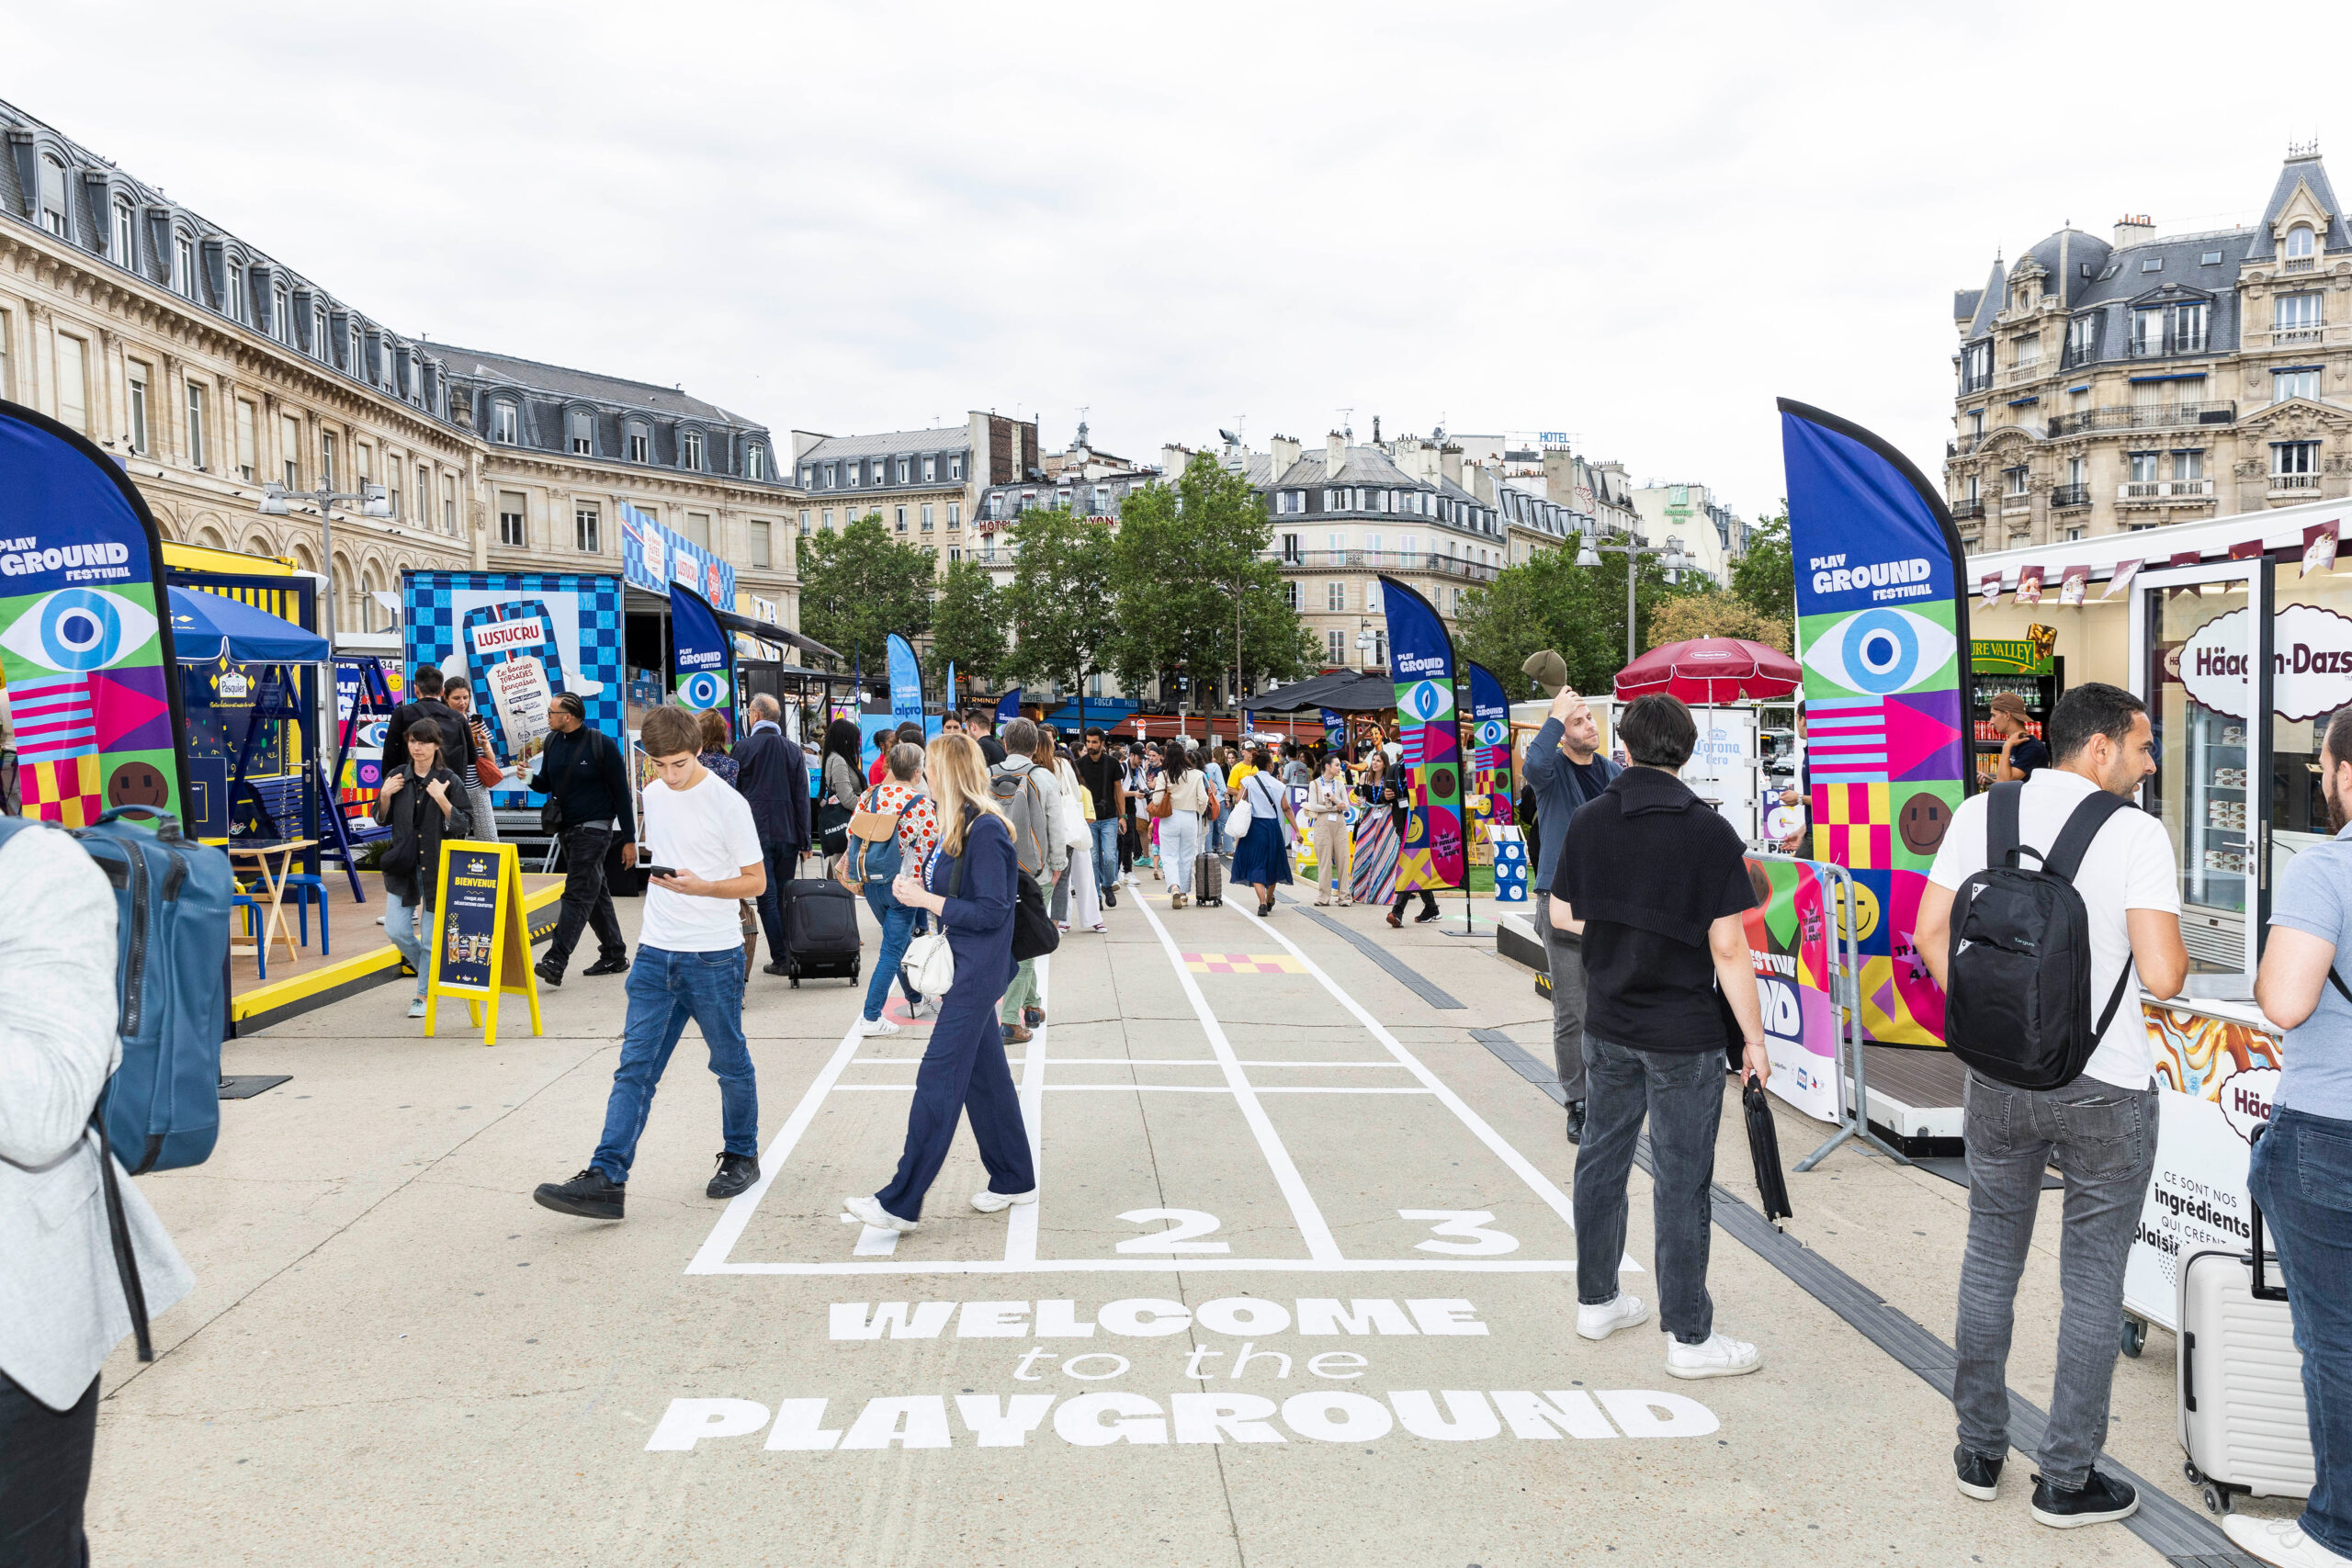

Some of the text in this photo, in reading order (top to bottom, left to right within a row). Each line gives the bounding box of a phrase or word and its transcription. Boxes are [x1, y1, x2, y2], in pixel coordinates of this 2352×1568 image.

[1539, 432, 1570, 444] HOTEL
[1664, 507, 1693, 516] Holiday
[0, 536, 37, 551] PLAY
[0, 543, 129, 577] GROUND
[1810, 553, 1846, 570] PLAY
[65, 567, 131, 581] FESTIVAL
[1813, 558, 1931, 594] GROUND
[1872, 583, 1932, 601] FESTIVAL
[478, 625, 539, 647] LUSTUCRU
[680, 651, 721, 666] GROUND
[1397, 652, 1414, 661] PLAY
[1991, 643, 2032, 664] VALLEY
[1399, 657, 1444, 672] GROUND
[2196, 643, 2352, 683] Häan-Dazs
[221, 681, 245, 695] Pasquier
[1023, 694, 1044, 703] HOTEL
[895, 703, 922, 718] alpro
[1476, 707, 1504, 716] GROUND
[1326, 717, 1344, 726] GROU
[1692, 739, 1742, 757] Corona
[824, 822, 849, 835] SAMSUN
[454, 876, 497, 889] BIENVENUE
[2014, 936, 2035, 947] Targus
[1909, 968, 1921, 979] 4
[2164, 1171, 2237, 1208] CE SONT NOS
[2154, 1182, 2251, 1238] ingrédients
[1115, 1208, 1231, 1256] 2
[1397, 1208, 1521, 1256] 3
[2161, 1216, 2181, 1233] QUI
[829, 1296, 1490, 1341] WELCOME
[1016, 1344, 1369, 1382] to the
[645, 1390, 1721, 1451] PLAYGROUND
